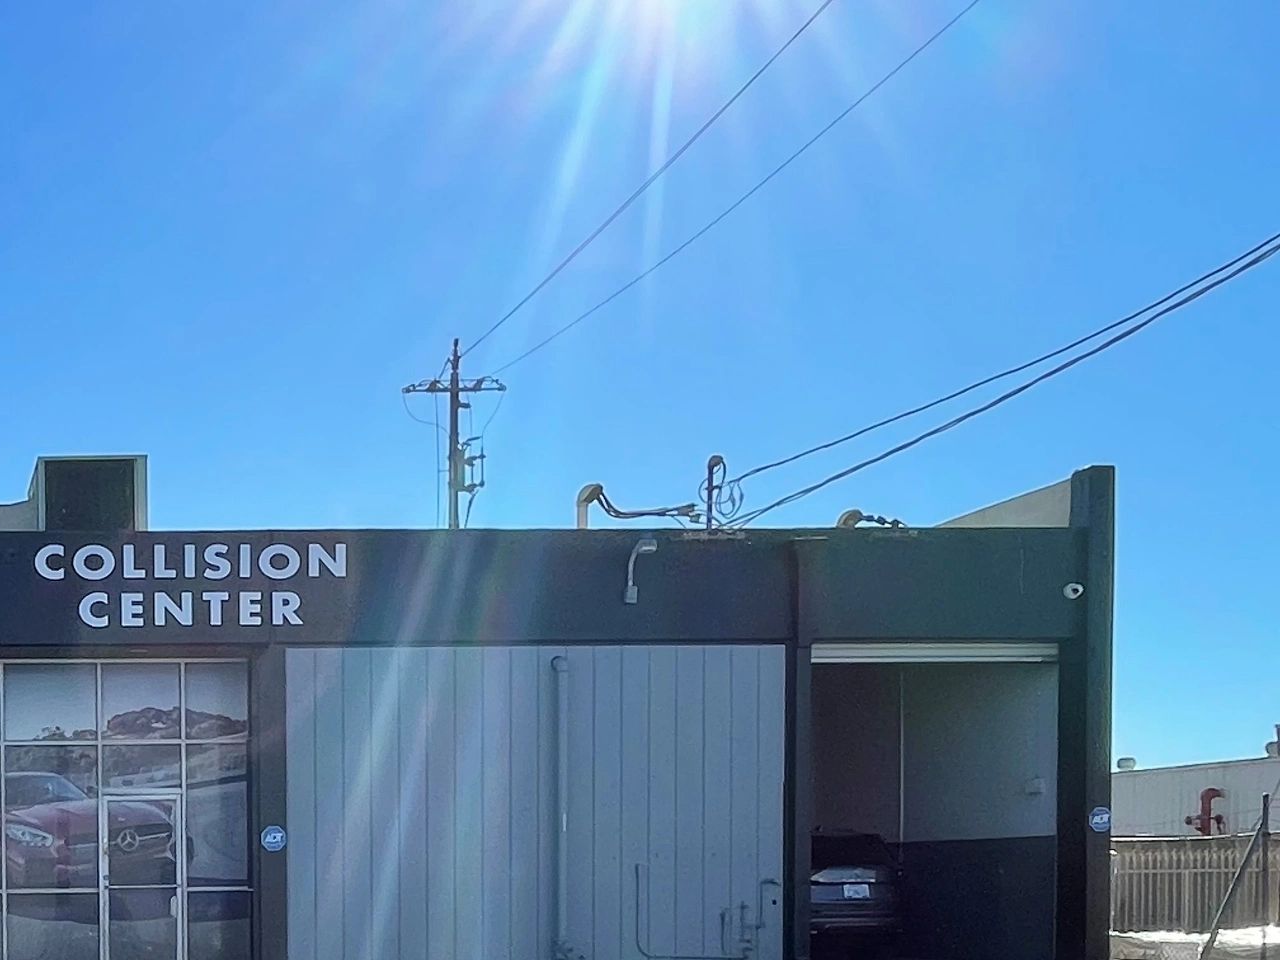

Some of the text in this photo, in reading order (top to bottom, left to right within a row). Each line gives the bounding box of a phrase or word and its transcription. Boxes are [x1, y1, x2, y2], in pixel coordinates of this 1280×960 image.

[34, 543, 347, 580] COLLISION
[78, 591, 304, 627] CENTER
[264, 832, 283, 842] ADT
